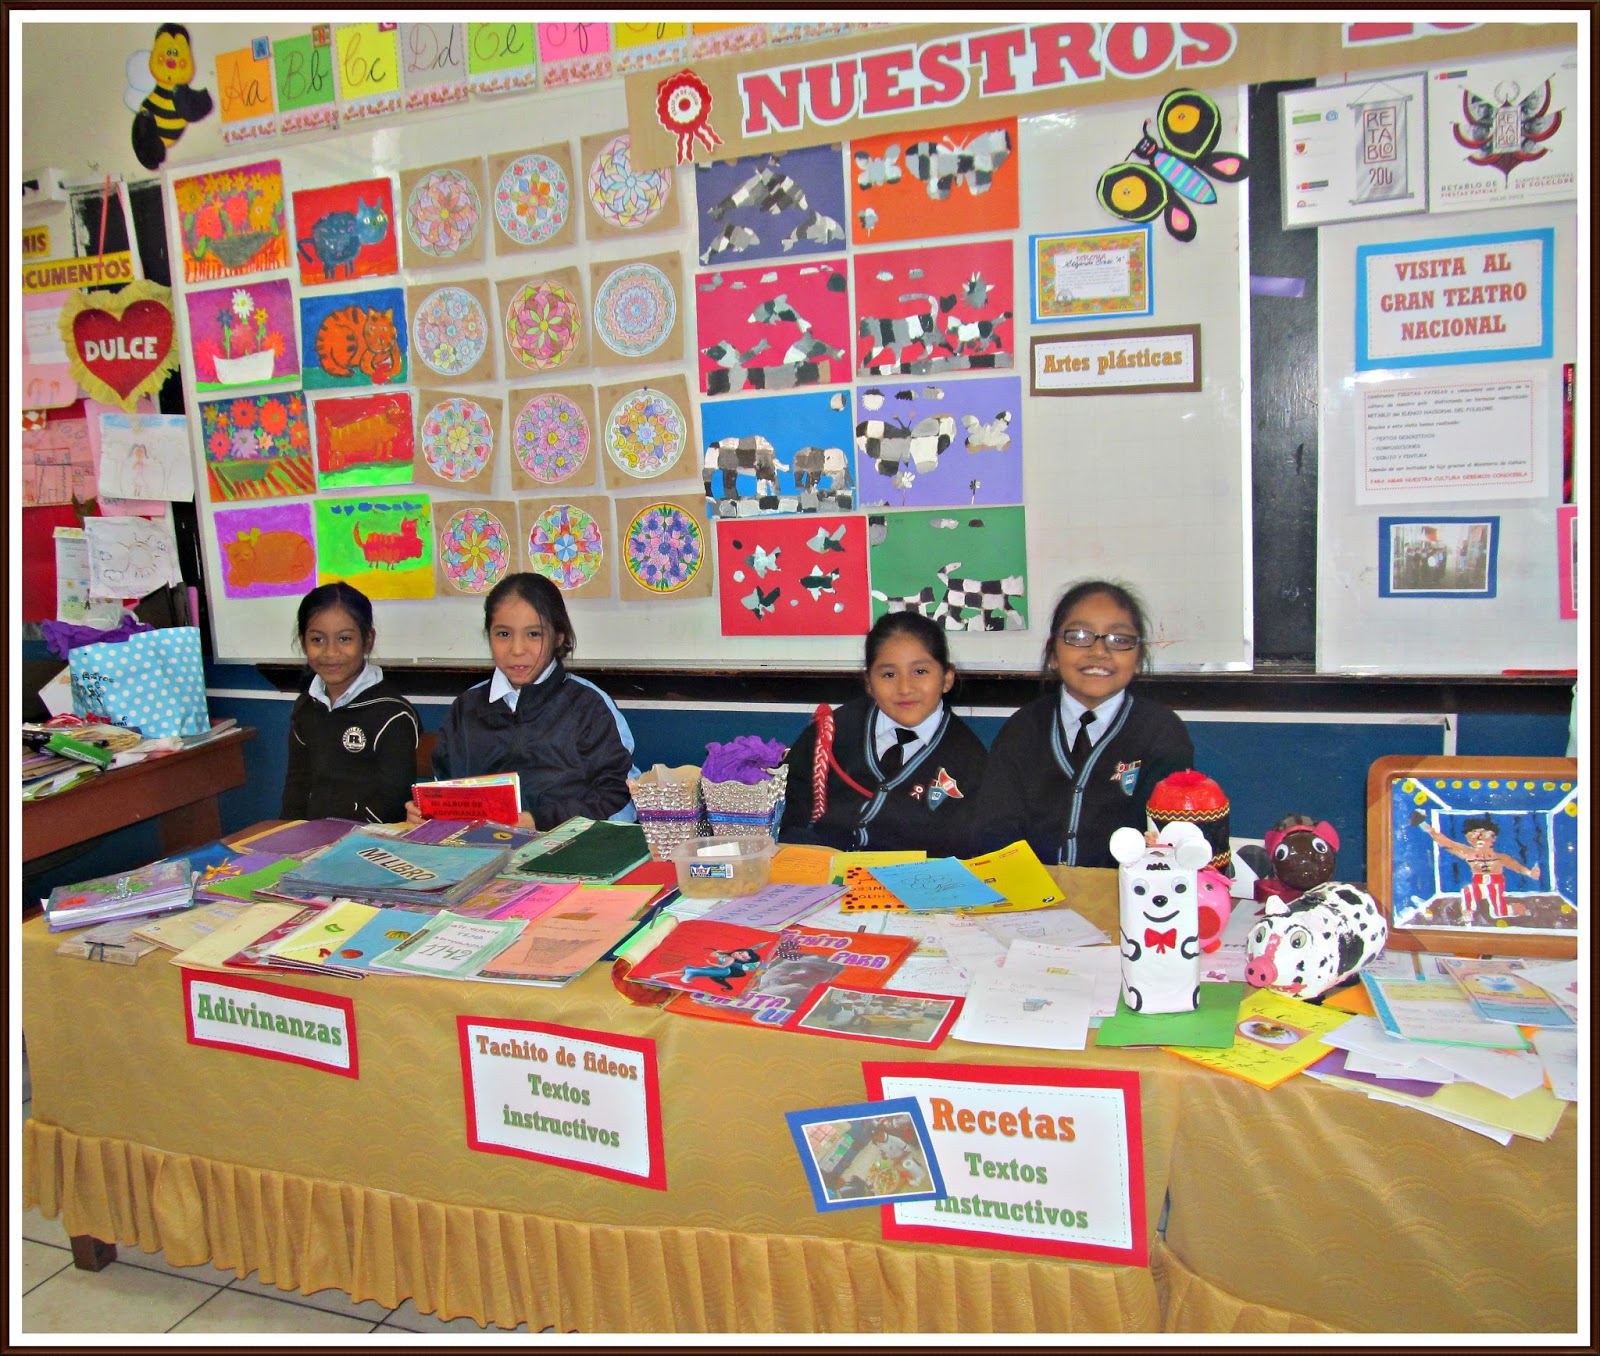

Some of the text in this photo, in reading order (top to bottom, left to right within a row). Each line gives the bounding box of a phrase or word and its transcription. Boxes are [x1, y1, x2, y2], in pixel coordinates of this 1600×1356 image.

[742, 23, 1236, 136] NUESTROS
[22, 259, 131, 289] CUMENTOS
[1394, 252, 1512, 282] VISITA AL
[1380, 281, 1528, 313] GRAN TEATRO
[1401, 314, 1507, 341] NACIONAL
[84, 336, 158, 362] DULCE
[1043, 348, 1183, 376] Artes plásticas
[358, 847, 436, 881] MI LIBRO
[831, 951, 887, 969] PARA
[197, 993, 343, 1047] Adivinanzas
[475, 1034, 638, 1081] Tachito de fideos
[527, 1072, 591, 1107] Textos
[502, 1103, 620, 1148] instructivos
[929, 1096, 1077, 1143] Recetas
[963, 1151, 1049, 1185] Textos
